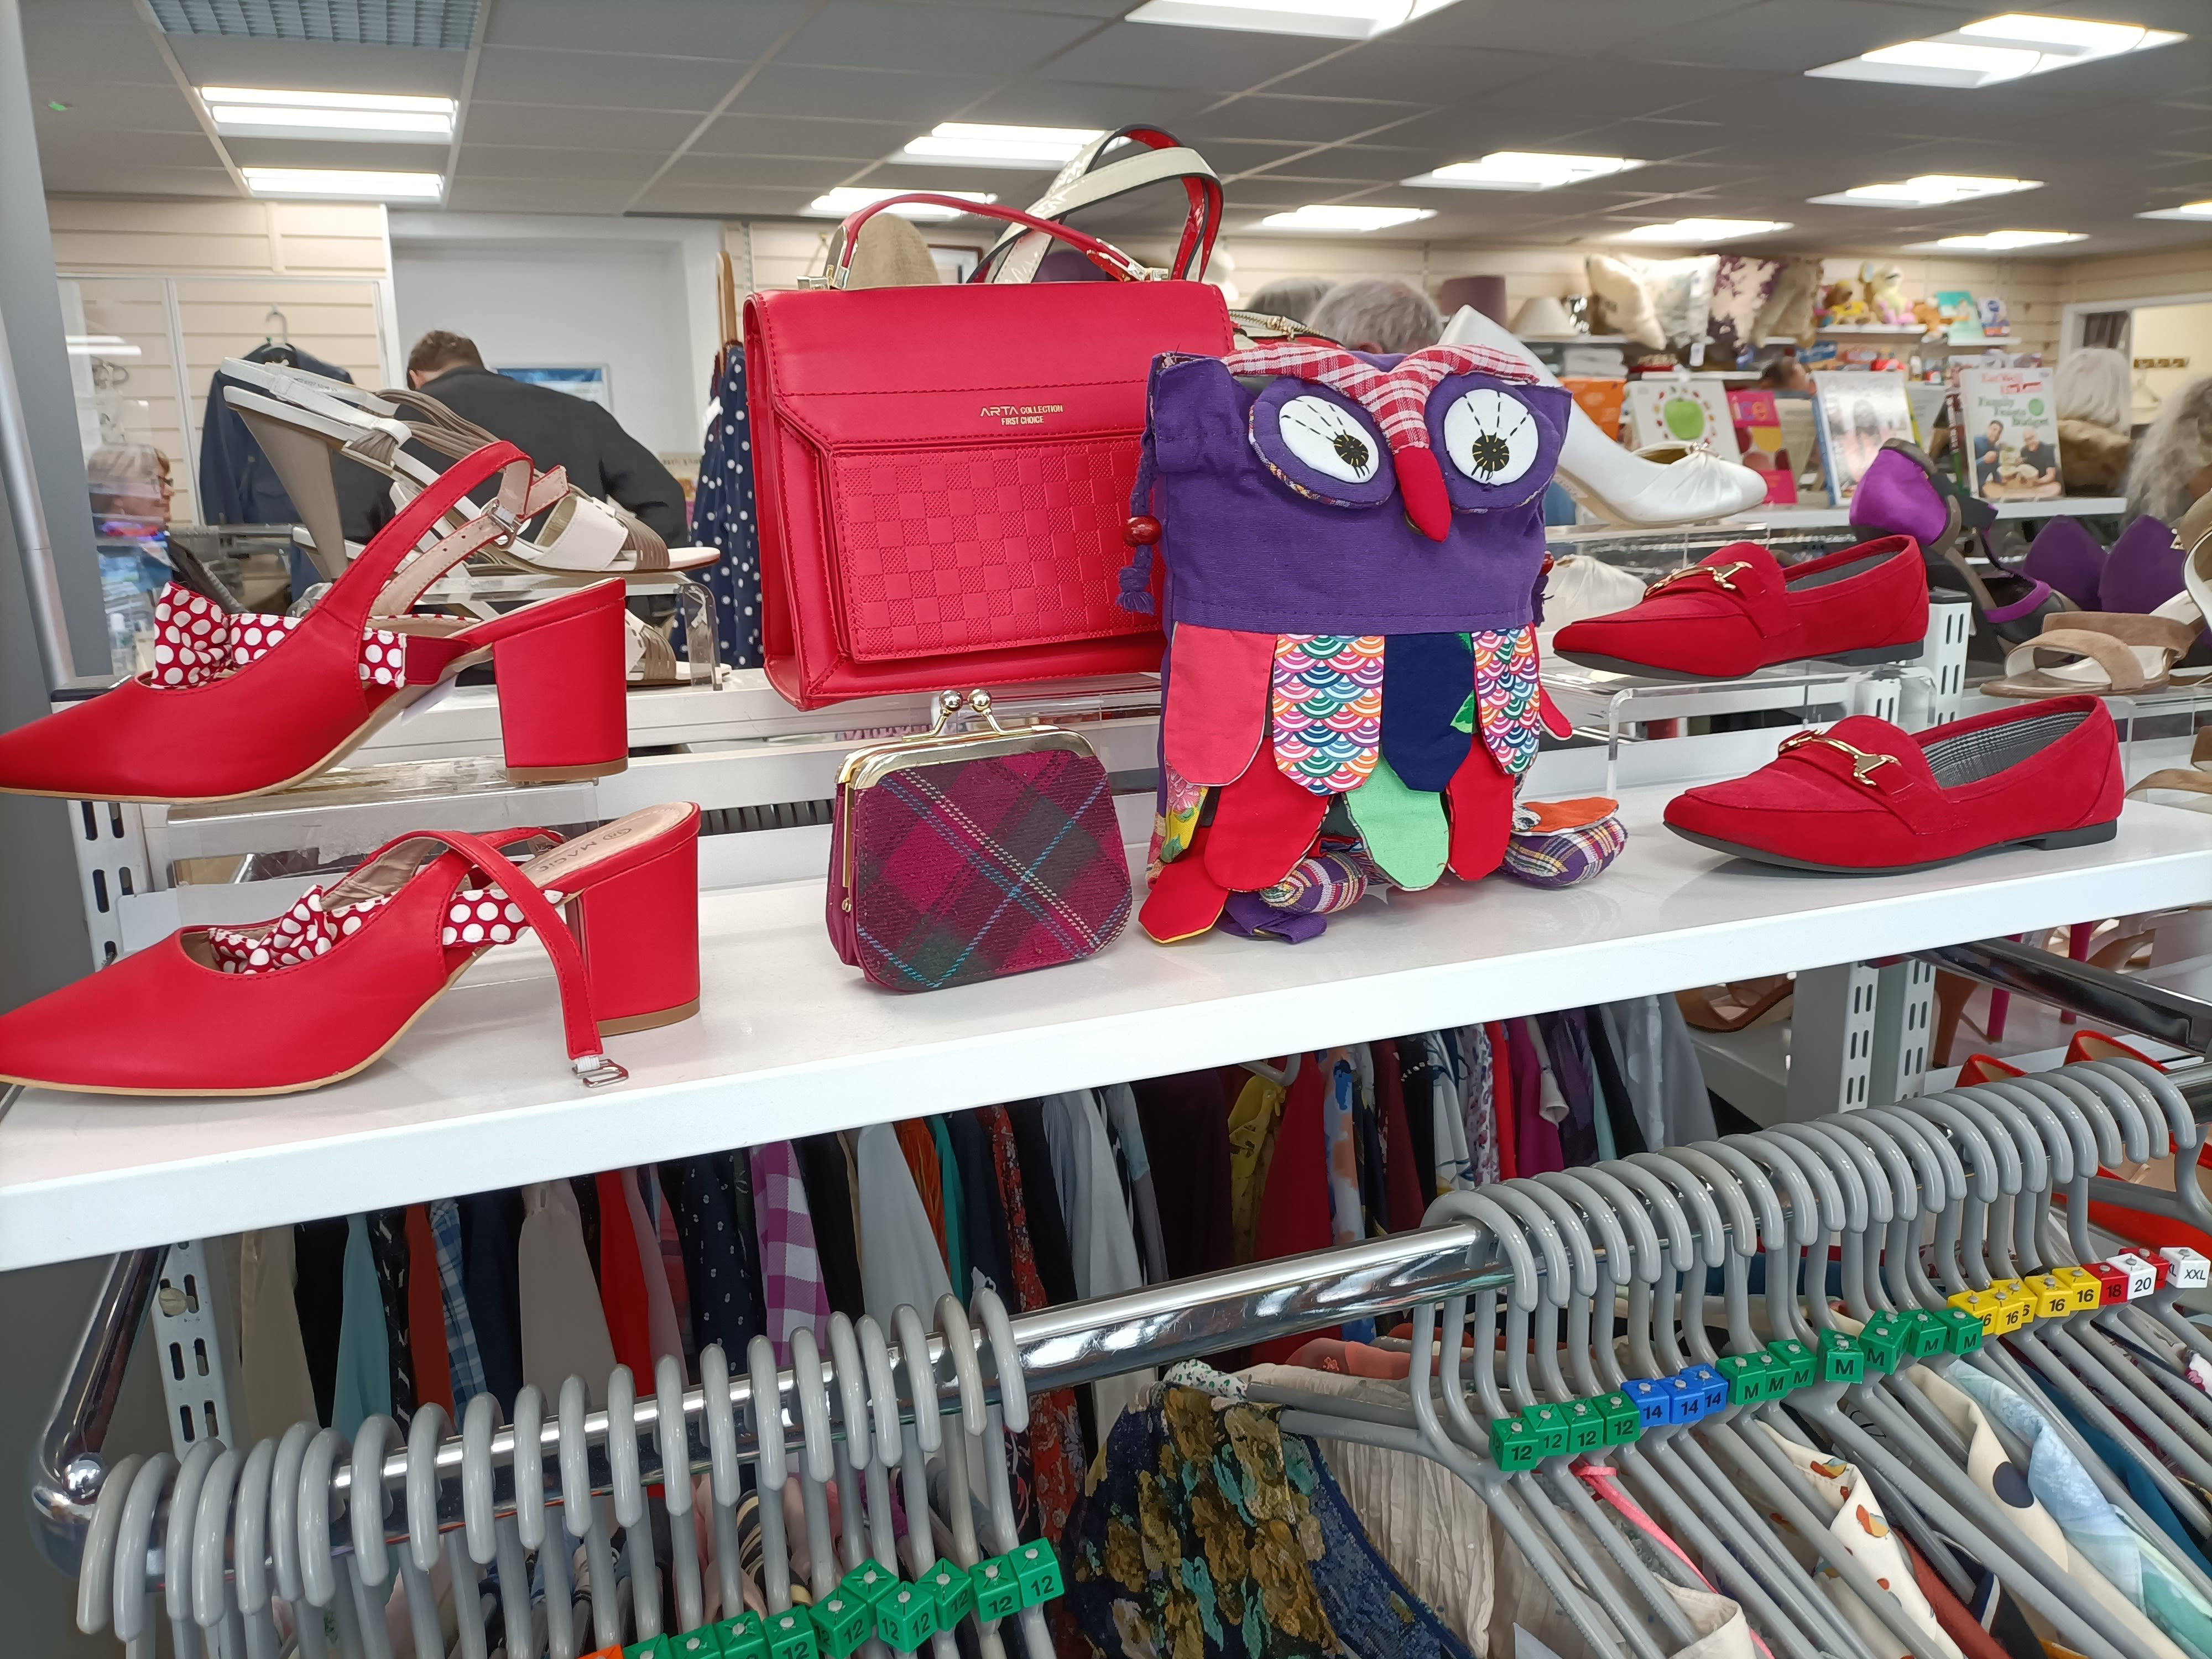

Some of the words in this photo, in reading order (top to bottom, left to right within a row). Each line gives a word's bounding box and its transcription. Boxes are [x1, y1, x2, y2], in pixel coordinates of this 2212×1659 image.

[980, 406, 1019, 417] ARTA
[1020, 404, 1063, 414] COLLECTION
[1001, 417, 1019, 425] FIRST
[1020, 416, 1044, 425] CHOICE
[2184, 1269, 2206, 1280] XXL
[2106, 1284, 2122, 1298] 18
[2134, 1277, 2152, 1293] 20
[2077, 1289, 2094, 1302] 16
[2022, 1304, 2030, 1317] 6
[2049, 1298, 2065, 1312] 16
[2006, 1311, 2019, 1325] 16
[1924, 1338, 1939, 1353] M
[1964, 1333, 1977, 1349] M
[1866, 1347, 1885, 1366] M
[1835, 1359, 1854, 1375] M
[1768, 1376, 1785, 1393] M
[1793, 1369, 1809, 1384] M
[1705, 1392, 1721, 1407] 14
[1744, 1383, 1759, 1400] M
[1643, 1405, 1663, 1420] 14
[1681, 1399, 1699, 1416] 14
[1614, 1419, 1634, 1436] 12
[1543, 1433, 1562, 1449] 12
[1578, 1430, 1597, 1447] 12
[1511, 1445, 1532, 1461] 12
[1030, 1575, 1055, 1597] 12
[951, 1589, 968, 1613] 12
[988, 1595, 1014, 1615] 12
[843, 1619, 864, 1644] 12
[881, 1618, 899, 1641] 12
[912, 1612, 931, 1638] 12
[782, 1641, 810, 1659] 12
